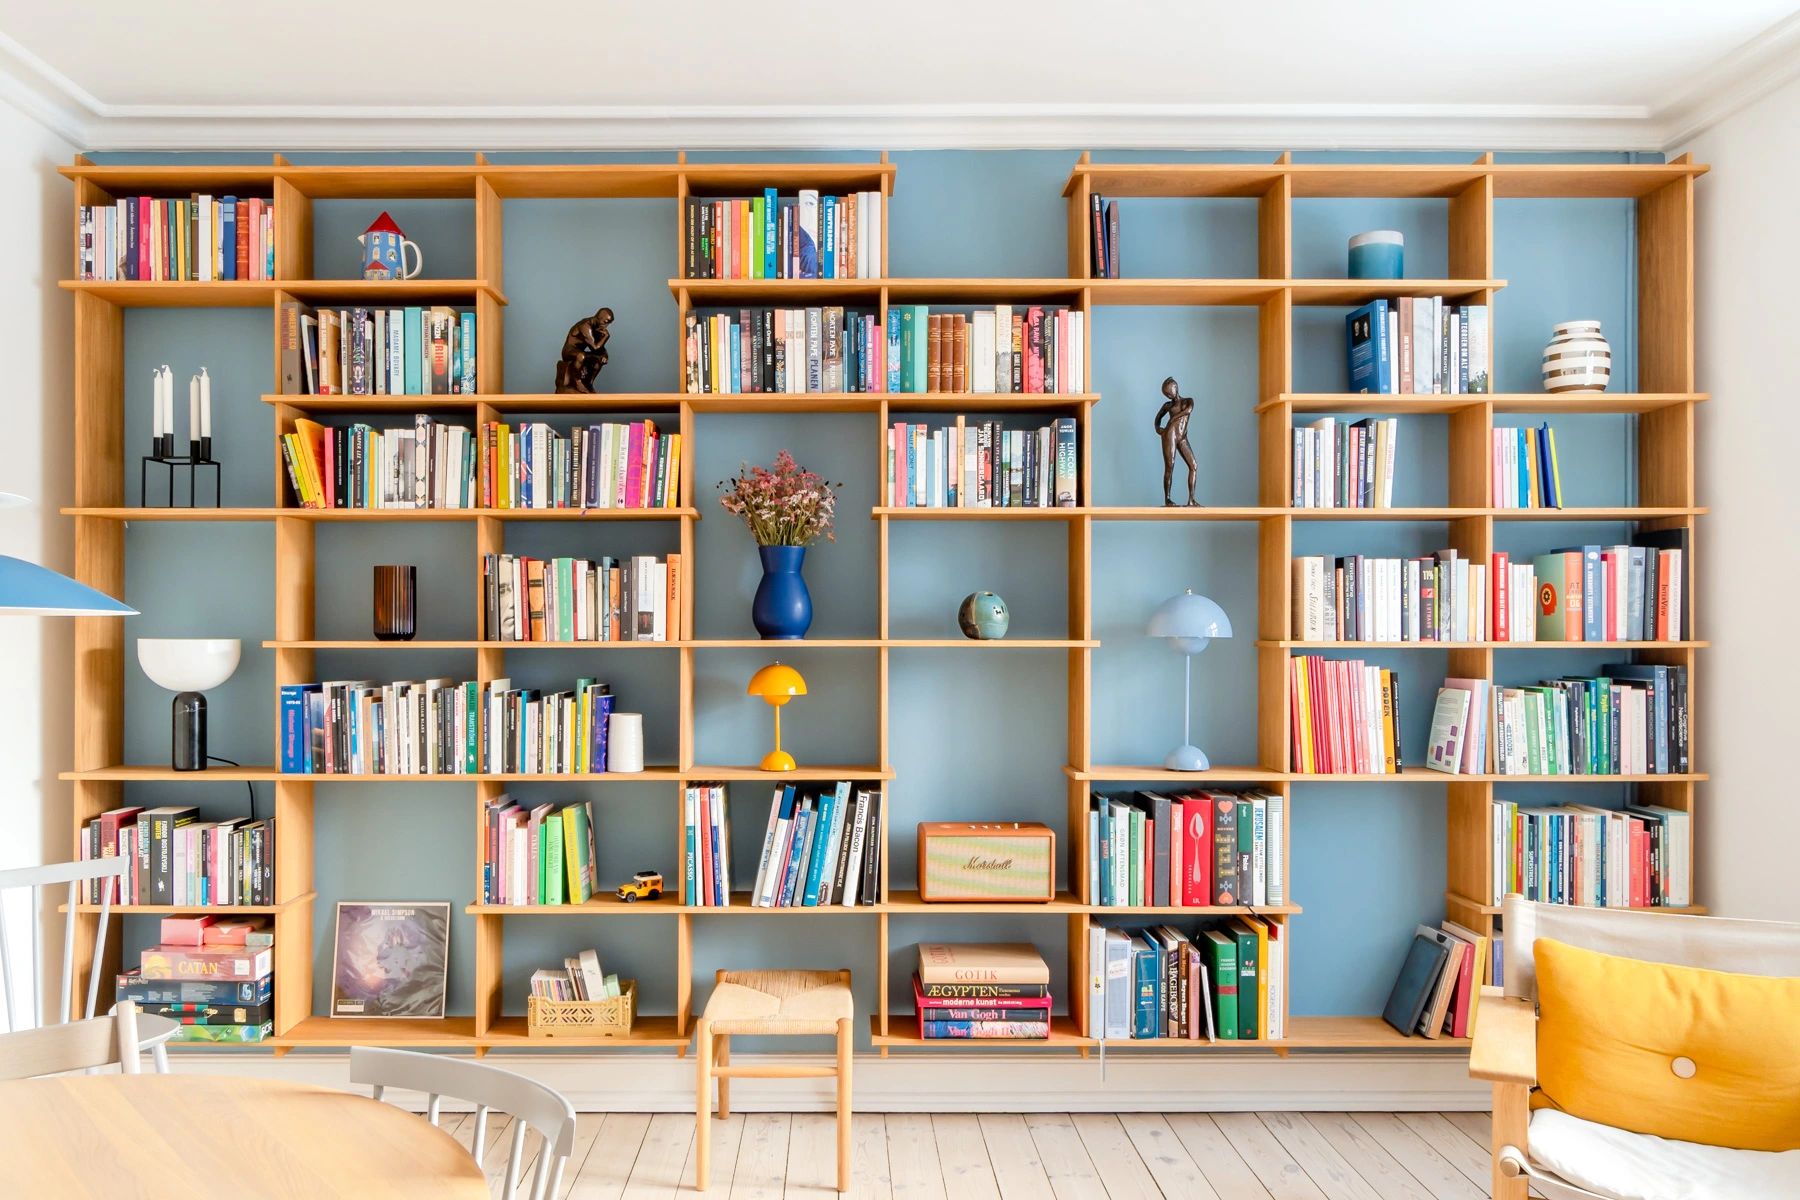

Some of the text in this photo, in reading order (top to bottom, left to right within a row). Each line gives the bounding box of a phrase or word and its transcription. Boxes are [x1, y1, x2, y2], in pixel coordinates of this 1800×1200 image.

[853, 796, 868, 852] Francis Bacon
[1255, 808, 1263, 840] JERUSALEM
[963, 856, 1013, 870] Marshall
[178, 961, 218, 974] CATAN
[955, 970, 997, 980] GOTIK
[928, 986, 998, 997] ÆGYPTEN
[948, 1010, 967, 1018] Van
[971, 1010, 998, 1020] Gogh
[948, 1026, 967, 1035] Van
[971, 1026, 998, 1037] Gogh
